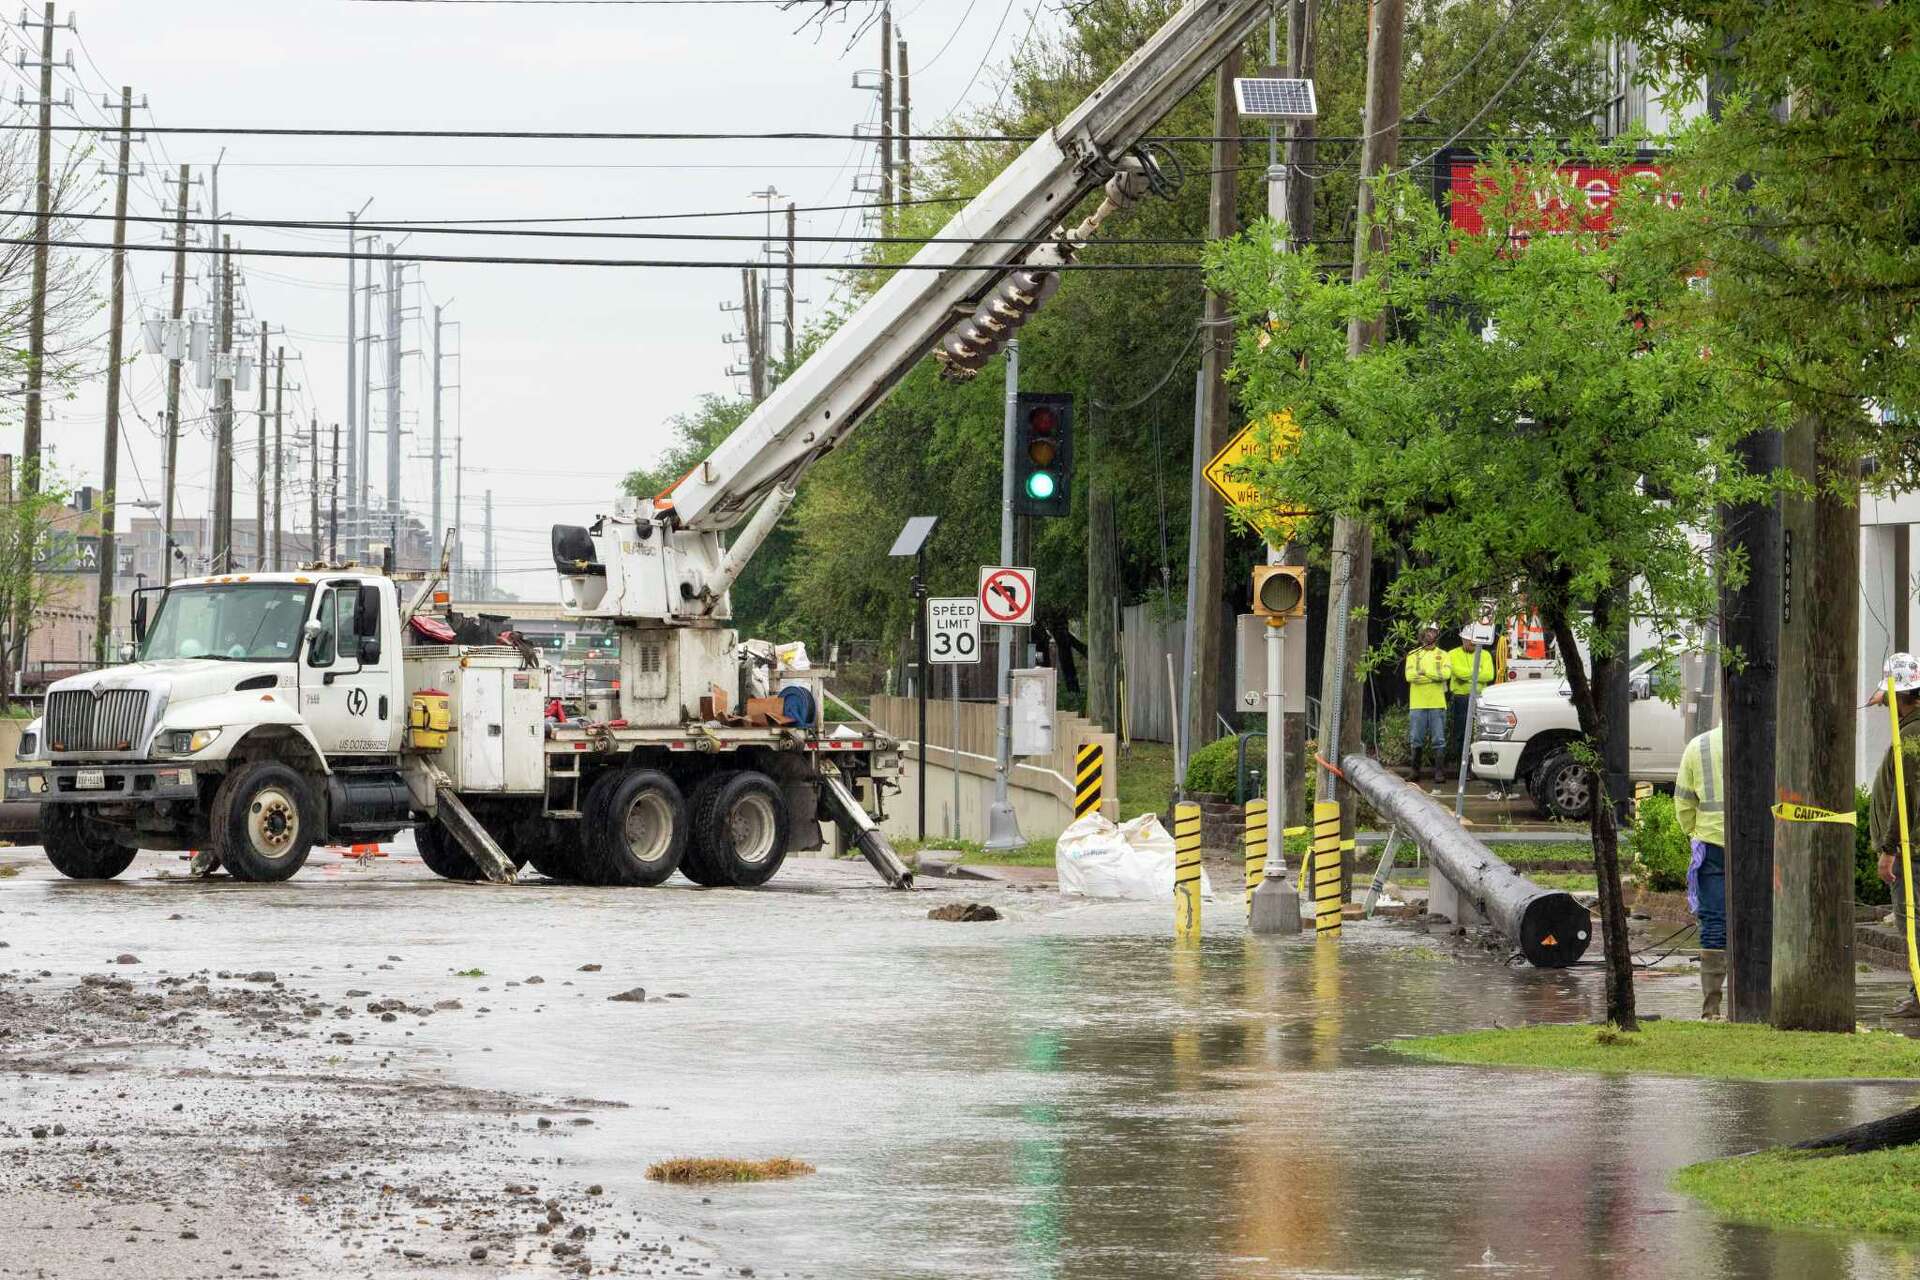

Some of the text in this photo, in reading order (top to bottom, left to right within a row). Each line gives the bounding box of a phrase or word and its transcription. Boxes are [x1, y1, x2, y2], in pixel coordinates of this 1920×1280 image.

[933, 606, 975, 616] SPEED
[937, 619, 970, 629] LIMIT
[934, 632, 975, 655] 30
